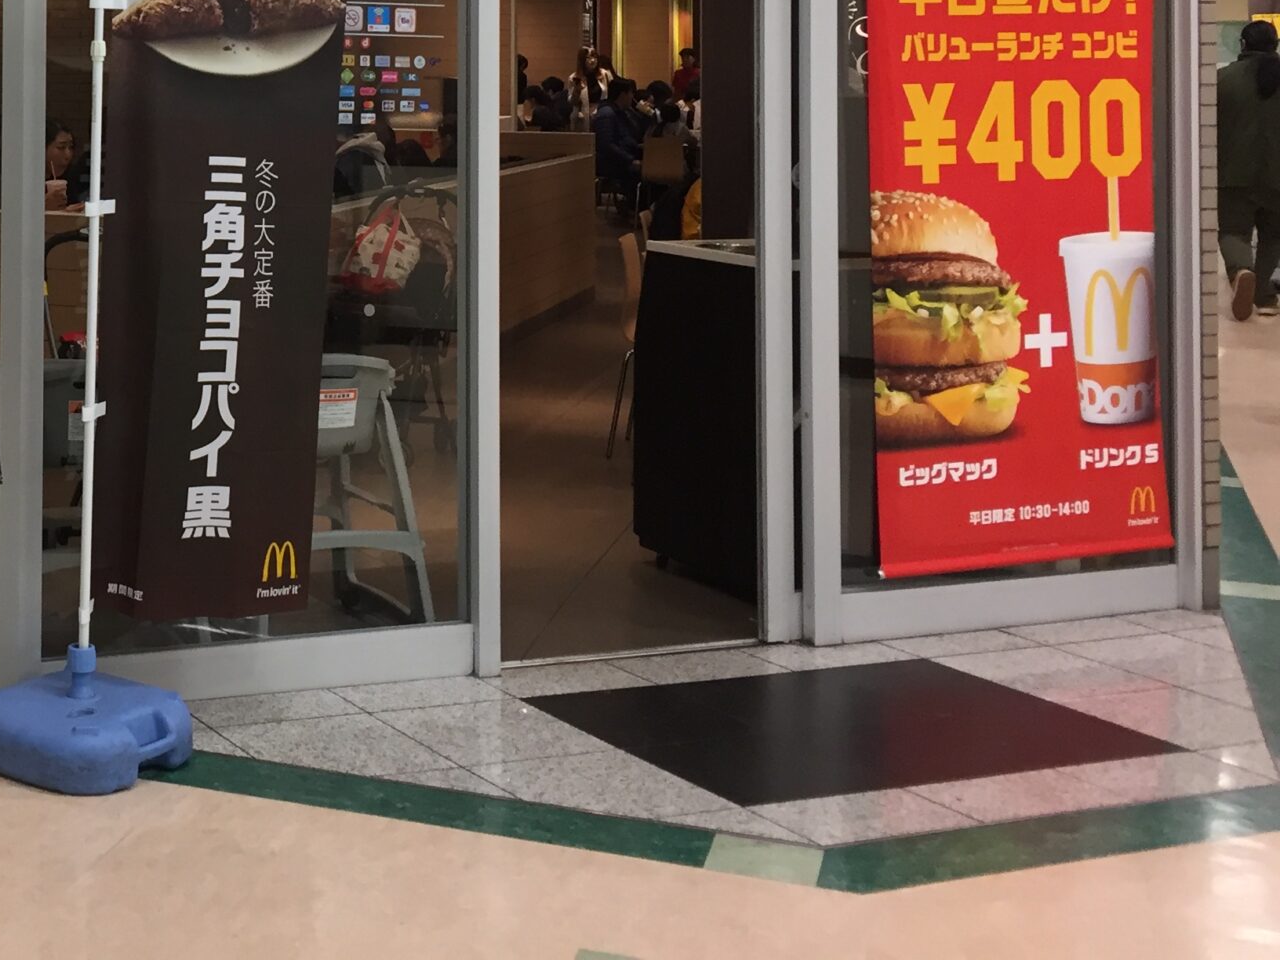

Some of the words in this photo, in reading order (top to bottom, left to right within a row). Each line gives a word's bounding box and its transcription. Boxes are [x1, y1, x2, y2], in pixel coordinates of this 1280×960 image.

[901, 32, 1064, 62] バリューランチ
[1072, 30, 1138, 59] コンビ
[901, 78, 1143, 184] ¥400
[252, 158, 279, 309] 冬の大定番
[1080, 444, 1142, 470] ドリンク
[1145, 442, 1159, 464] S
[898, 458, 998, 488] ビッグマック
[969, 507, 1016, 526] 平日限定
[1019, 500, 1091, 520] 10:30-14:00
